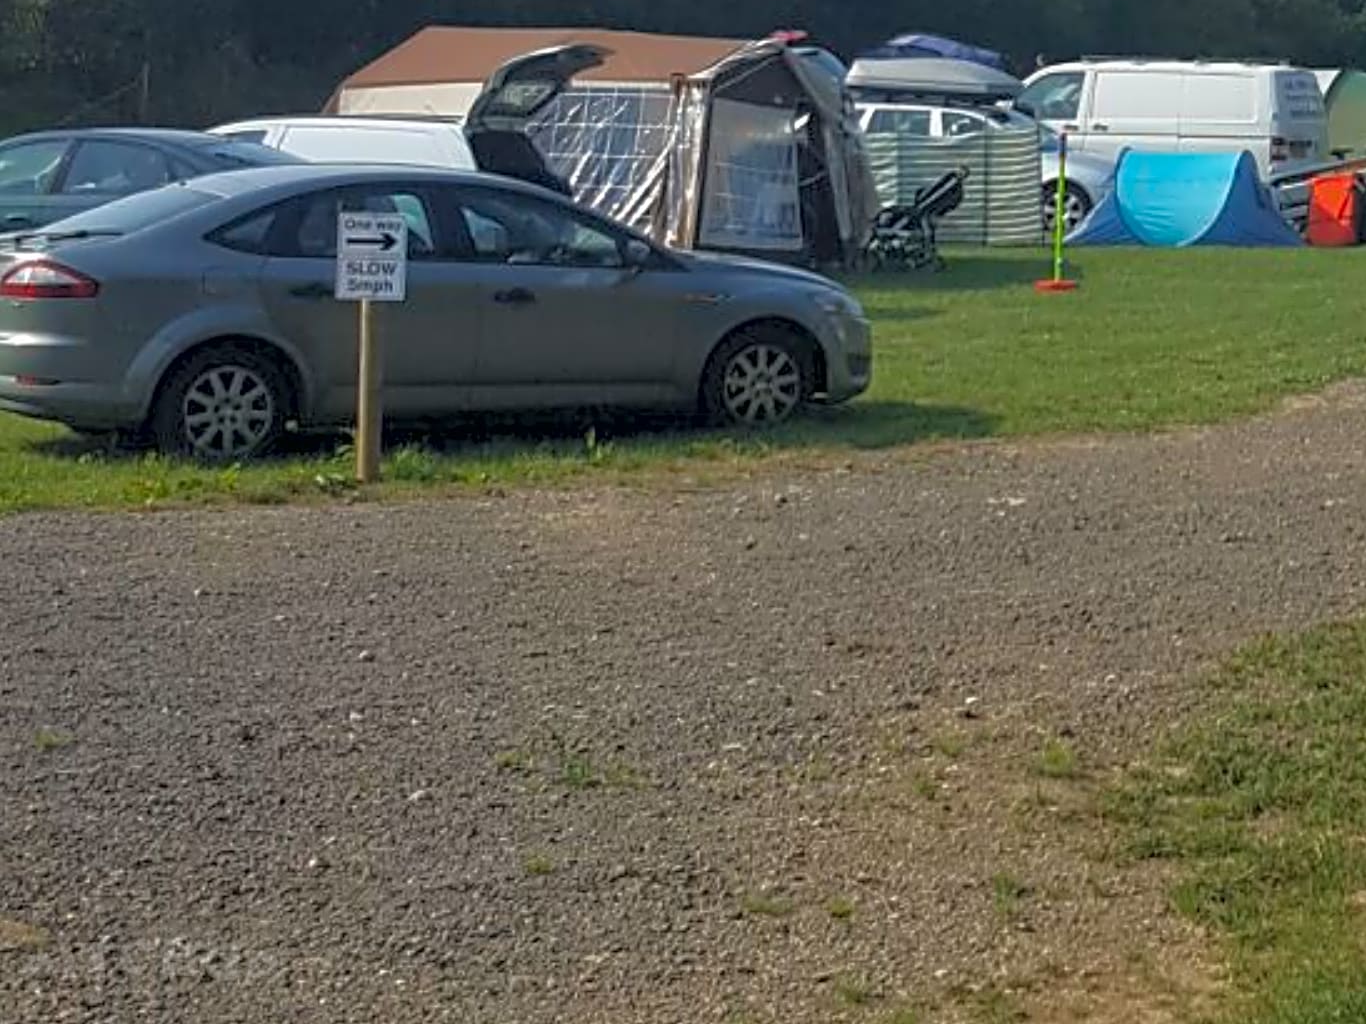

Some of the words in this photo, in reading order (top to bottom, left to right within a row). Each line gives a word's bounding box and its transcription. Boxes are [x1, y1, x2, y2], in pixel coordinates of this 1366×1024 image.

[344, 219, 371, 231] One
[376, 221, 402, 233] way
[345, 262, 398, 275] SLOW
[345, 278, 394, 294] 5mph
